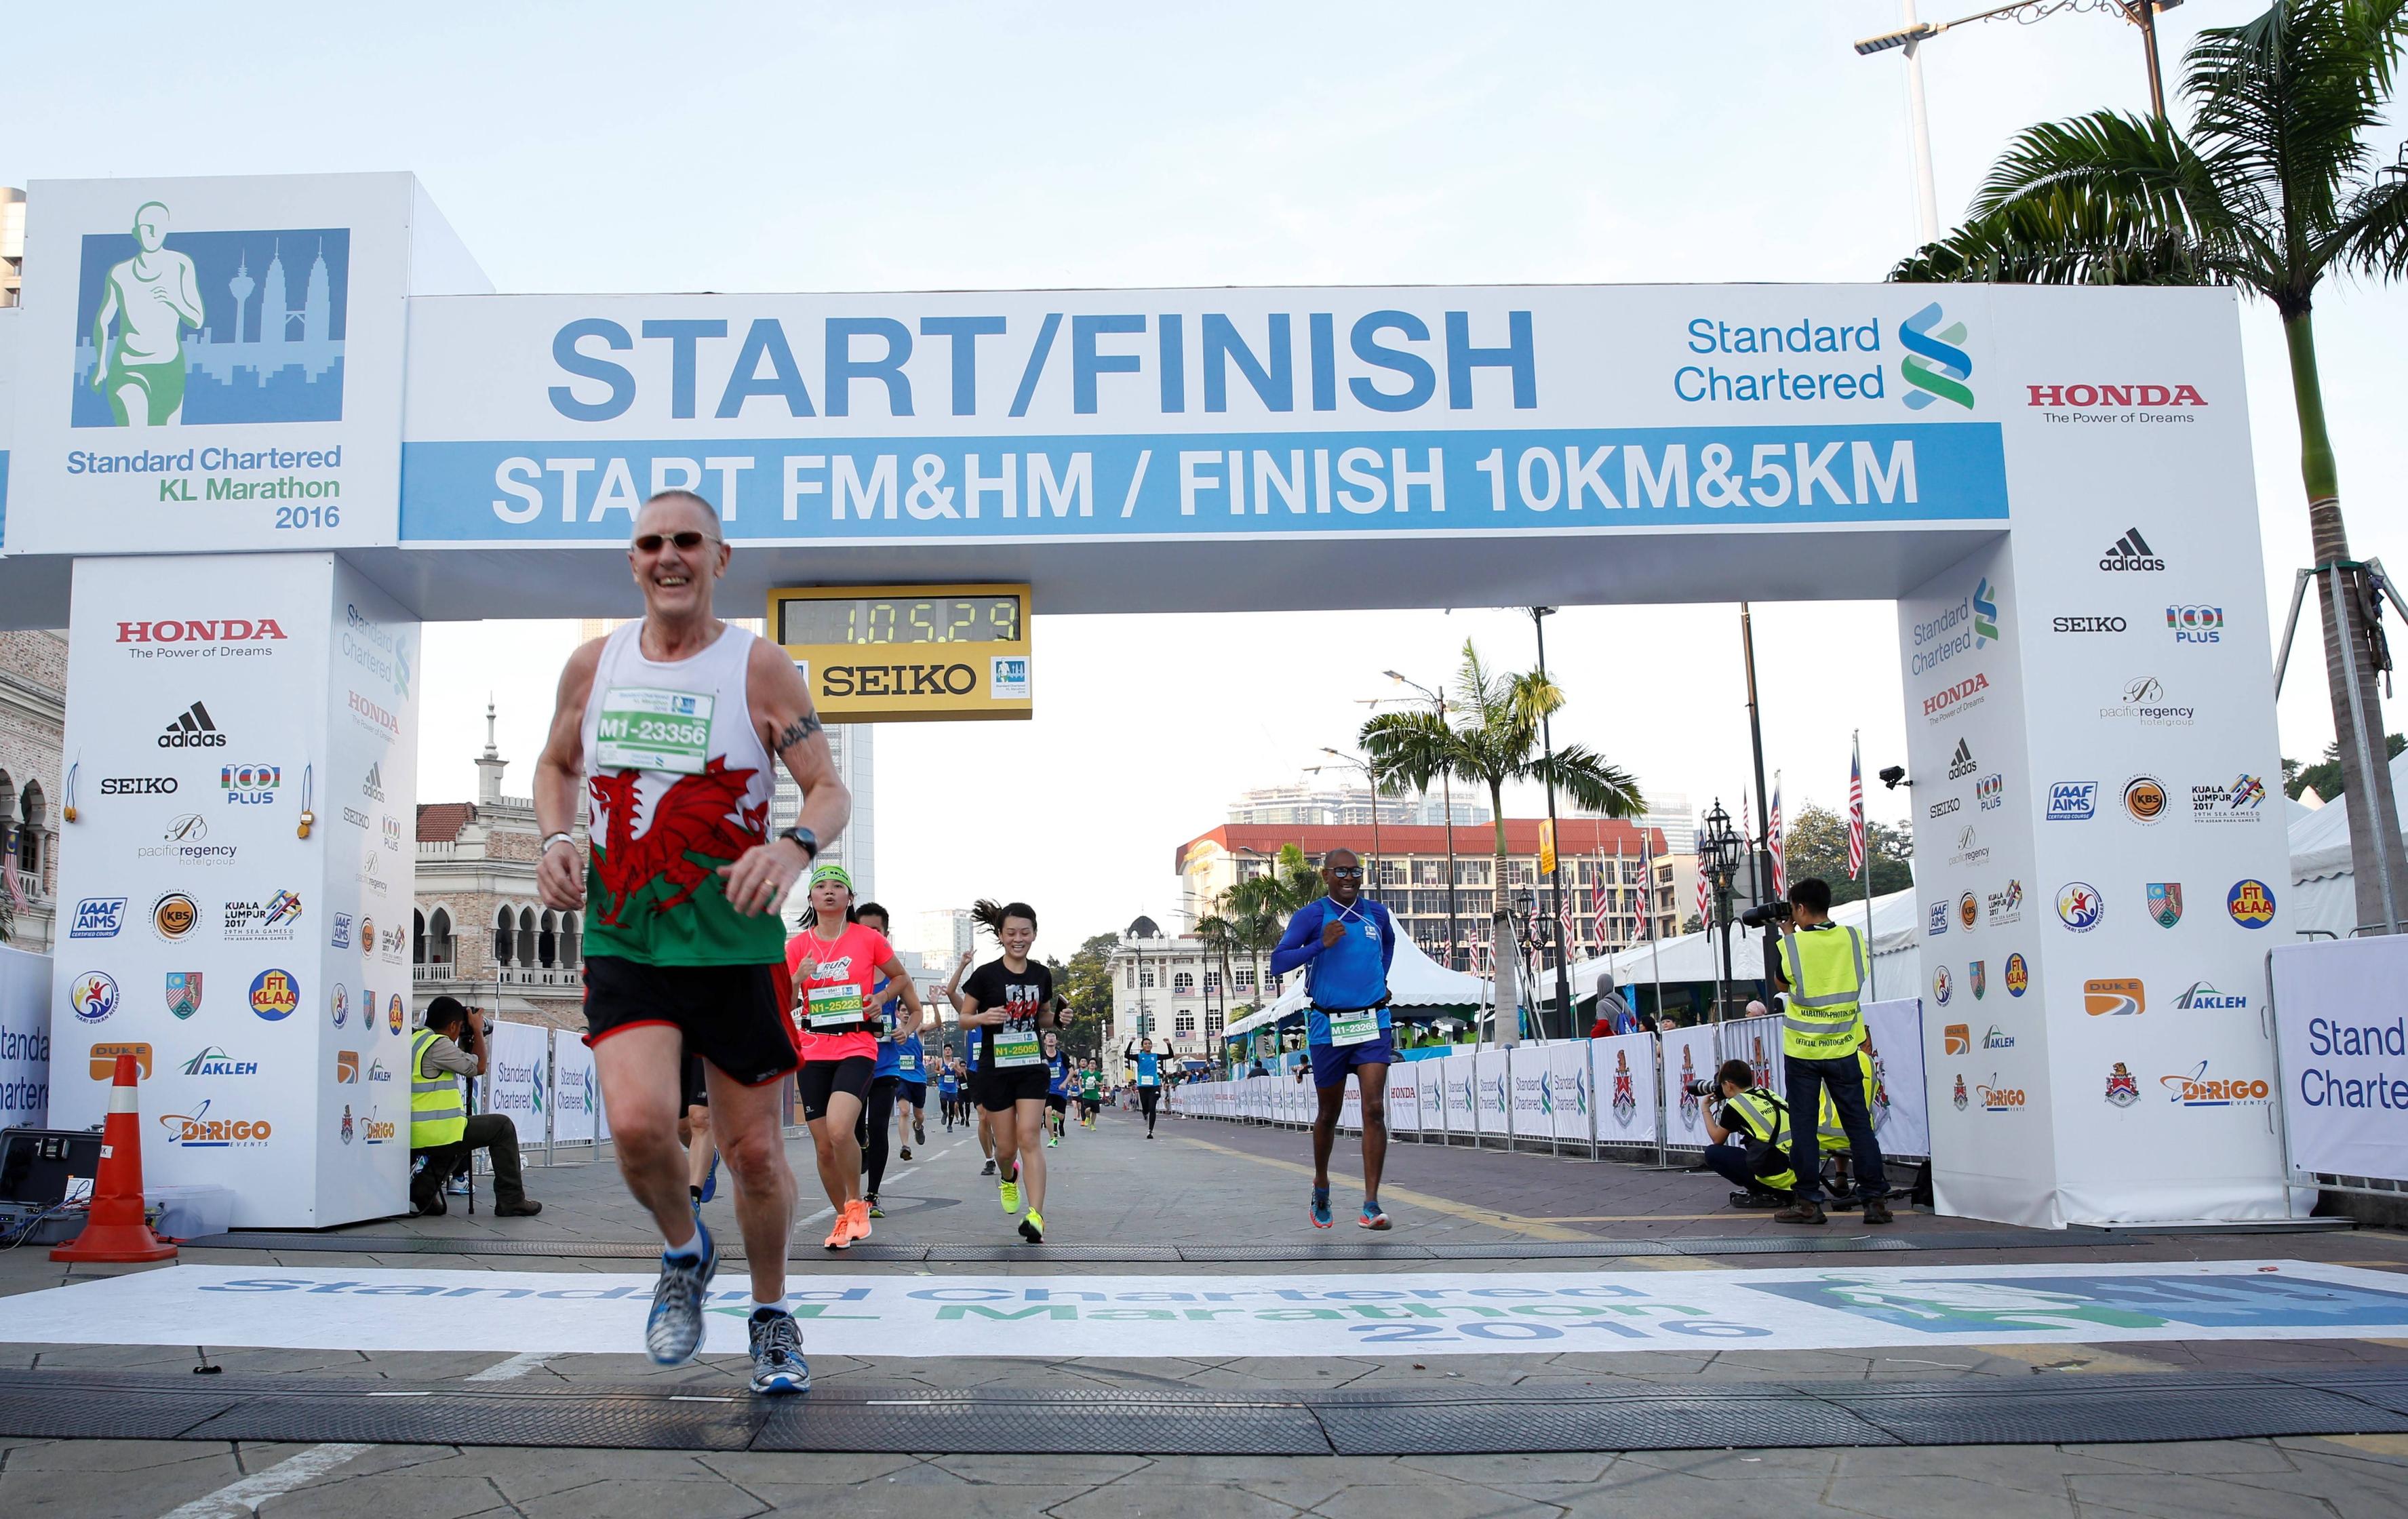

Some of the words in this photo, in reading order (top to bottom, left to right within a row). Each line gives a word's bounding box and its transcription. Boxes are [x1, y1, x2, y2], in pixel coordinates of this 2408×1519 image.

[1688, 317, 1880, 355] Standard
[548, 311, 1537, 422] START/FINISH
[1674, 365, 1884, 402] Chartered
[2026, 384, 2208, 407] HONDA
[2043, 413, 2070, 423] The
[2073, 413, 2117, 423] Power
[2120, 412, 2135, 422] of
[2139, 412, 2194, 423] Dreams
[67, 448, 194, 474] Standard
[199, 445, 341, 471] Chartered
[783, 452, 1093, 521] FM&HM
[1121, 450, 1151, 518] /
[1179, 447, 1445, 517] FINISH
[1476, 440, 1918, 512] 10KM&5KM
[159, 479, 197, 502] KL
[205, 476, 340, 500] Marathon
[275, 505, 340, 529] 2016
[2099, 555, 2165, 572] adidas
[1914, 597, 1969, 646] Standard
[2053, 616, 2127, 632] SEIKO
[2170, 604, 2218, 631] 100
[116, 619, 288, 643] HONDA
[347, 604, 393, 654] Standard
[2176, 631, 2219, 643] PLUS
[129, 648, 153, 658] The
[157, 648, 199, 658] Power
[202, 647, 217, 658] of
[220, 646, 273, 656] Dreams
[342, 632, 392, 684] Chartered
[1912, 626, 1971, 676] Chartered
[823, 663, 976, 697] SEIKO
[1923, 673, 1990, 716] HONDA
[1963, 696, 1984, 711] Dreams
[348, 689, 400, 735] HONDA
[157, 730, 226, 748] adidas
[599, 718, 707, 745] M1-23356
[226, 764, 277, 791] 100
[1948, 760, 1977, 781] adidas
[101, 777, 178, 795] SEIKO
[363, 783, 385, 804] adidas
[2053, 785, 2094, 797] IAAF
[2192, 785, 2224, 793] KUALA
[228, 792, 274, 804] PLUS
[1981, 798, 2001, 812] PLUS
[2052, 798, 2090, 811] AIMS
[2137, 795, 2160, 805] KBS
[1930, 797, 1960, 819] SEIKO
[343, 806, 370, 830] SEIKO
[384, 837, 399, 852] PLUS
[2243, 886, 2260, 900] FT
[80, 901, 123, 915] IAAF
[224, 902, 259, 910] KUALA
[1931, 904, 1947, 917] IAAF
[2230, 901, 2273, 914] KLAA
[78, 915, 116, 928] AIMS
[166, 911, 191, 922] KBS
[224, 911, 266, 919] LUMPUR
[335, 916, 351, 928] IAAF
[1931, 915, 1946, 928] AIMS
[224, 920, 246, 928] 2017
[334, 927, 349, 941] AIMS
[824, 960, 850, 970] RUN
[2012, 960, 2020, 971] FT
[267, 976, 285, 990] FT
[252, 991, 296, 1004] KLAA
[2193, 995, 2246, 1009] AKLEH
[811, 1000, 861, 1014] N1-25223
[1332, 1022, 1377, 1035] M1-23268
[2308, 1017, 2408, 1056] Stand
[1, 1025, 50, 1063] tanda
[995, 1045, 1038, 1056] N1-25050
[1796, 1038, 1816, 1047] OFFICIAL
[1990, 1037, 2015, 1048] AKLEH
[201, 1063, 258, 1075] AKLEH
[498, 1063, 532, 1083] Standard
[561, 1067, 583, 1086] Standard
[1516, 1077, 1540, 1091] Standard
[2300, 1069, 2408, 1110] Charte
[0, 1076, 49, 1110] arter
[494, 1089, 531, 1110] Chartered
[557, 1092, 583, 1110] Chartered
[1390, 1087, 1416, 1099] HONDA
[1515, 1096, 1540, 1111] Chartered
[197, 1279, 871, 1301] Standrd
[906, 1284, 1653, 1301] Chartered
[935, 1303, 1713, 1321] Marathon
[1348, 1320, 1773, 1343] 2016
